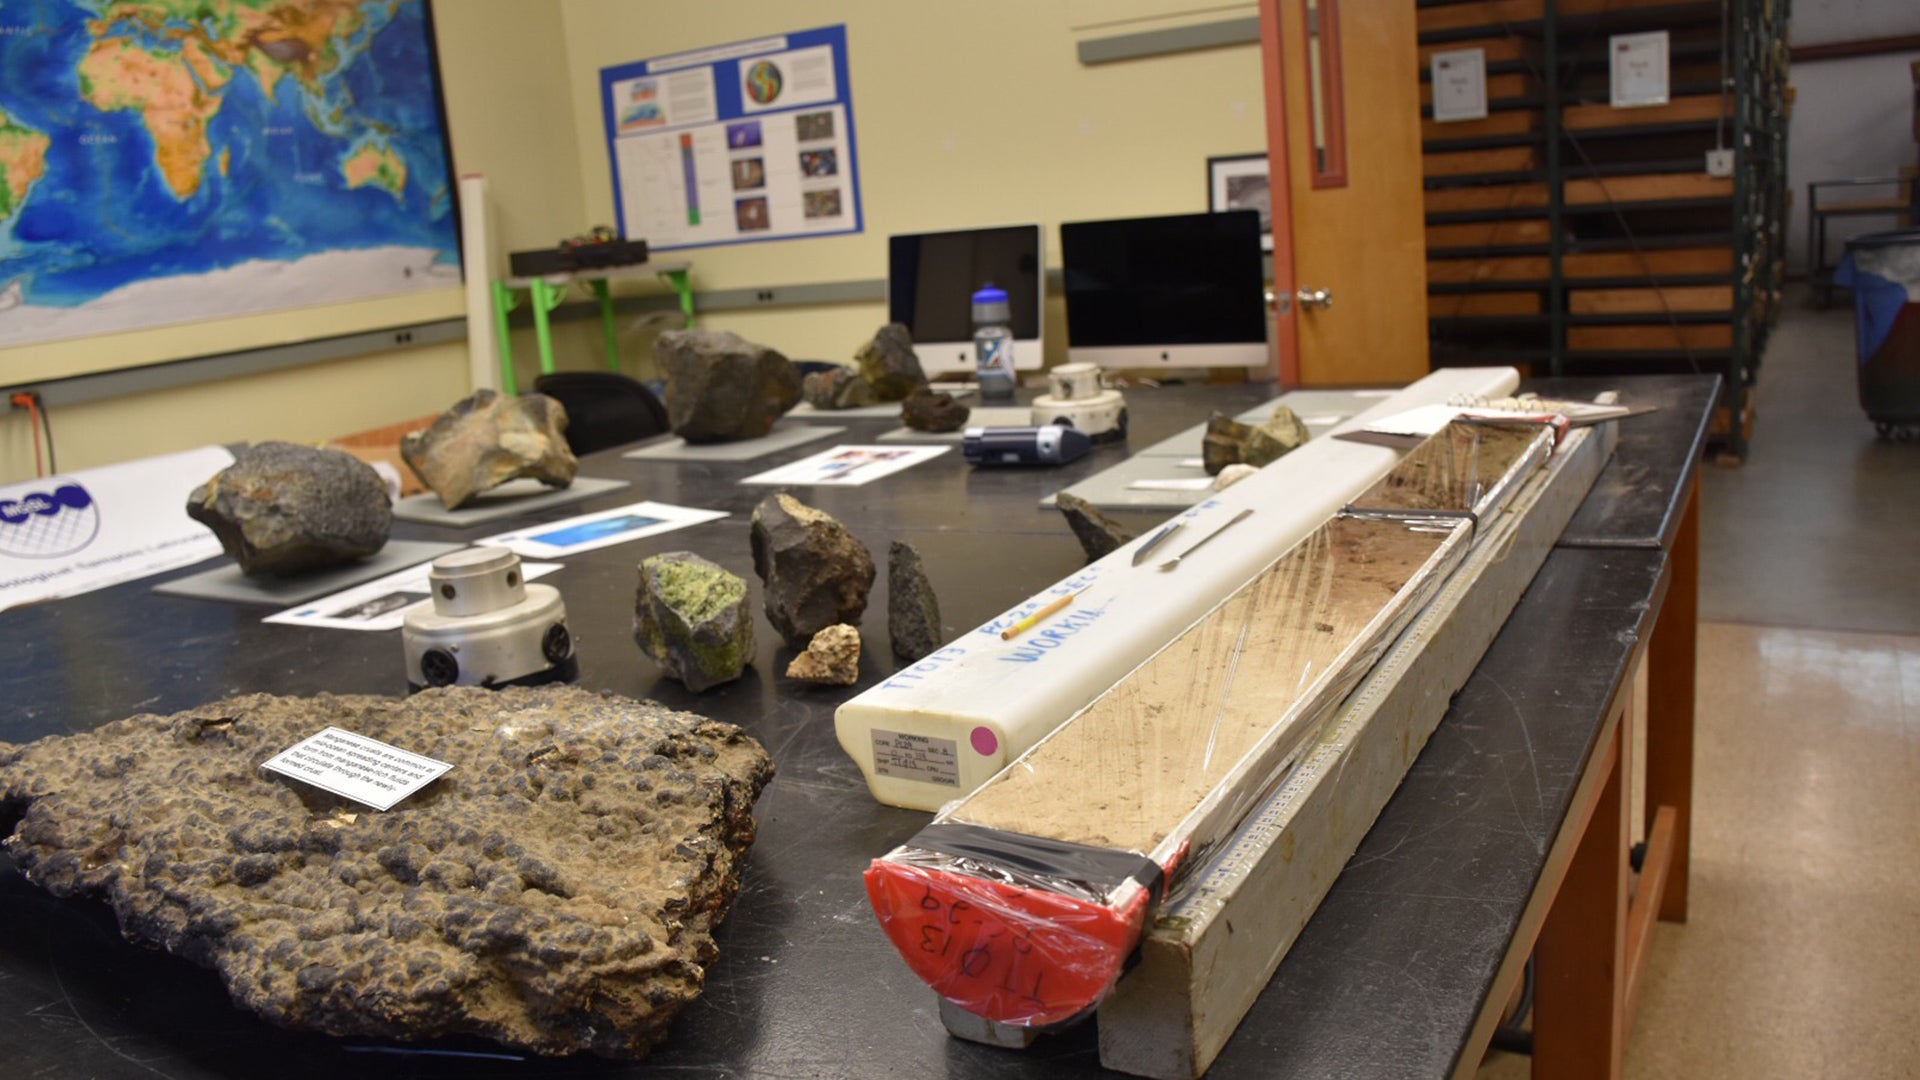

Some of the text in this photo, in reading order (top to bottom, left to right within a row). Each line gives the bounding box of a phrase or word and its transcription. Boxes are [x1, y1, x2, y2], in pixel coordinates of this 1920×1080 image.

[997, 596, 1118, 662] WORKIN
[324, 733, 437, 774] Manganese crusts are common at
[898, 733, 929, 744] WORKING
[280, 757, 306, 769] formed
[290, 751, 306, 759] that
[304, 756, 335, 769] circulate
[333, 765, 361, 779] through
[360, 775, 373, 783] the
[302, 744, 319, 753] form
[319, 750, 335, 758] from
[333, 756, 389, 778] manganese-rich
[346, 749, 382, 767] spreading
[380, 762, 409, 775] centers
[407, 771, 425, 780] and
[921, 883, 1034, 955] P-29
